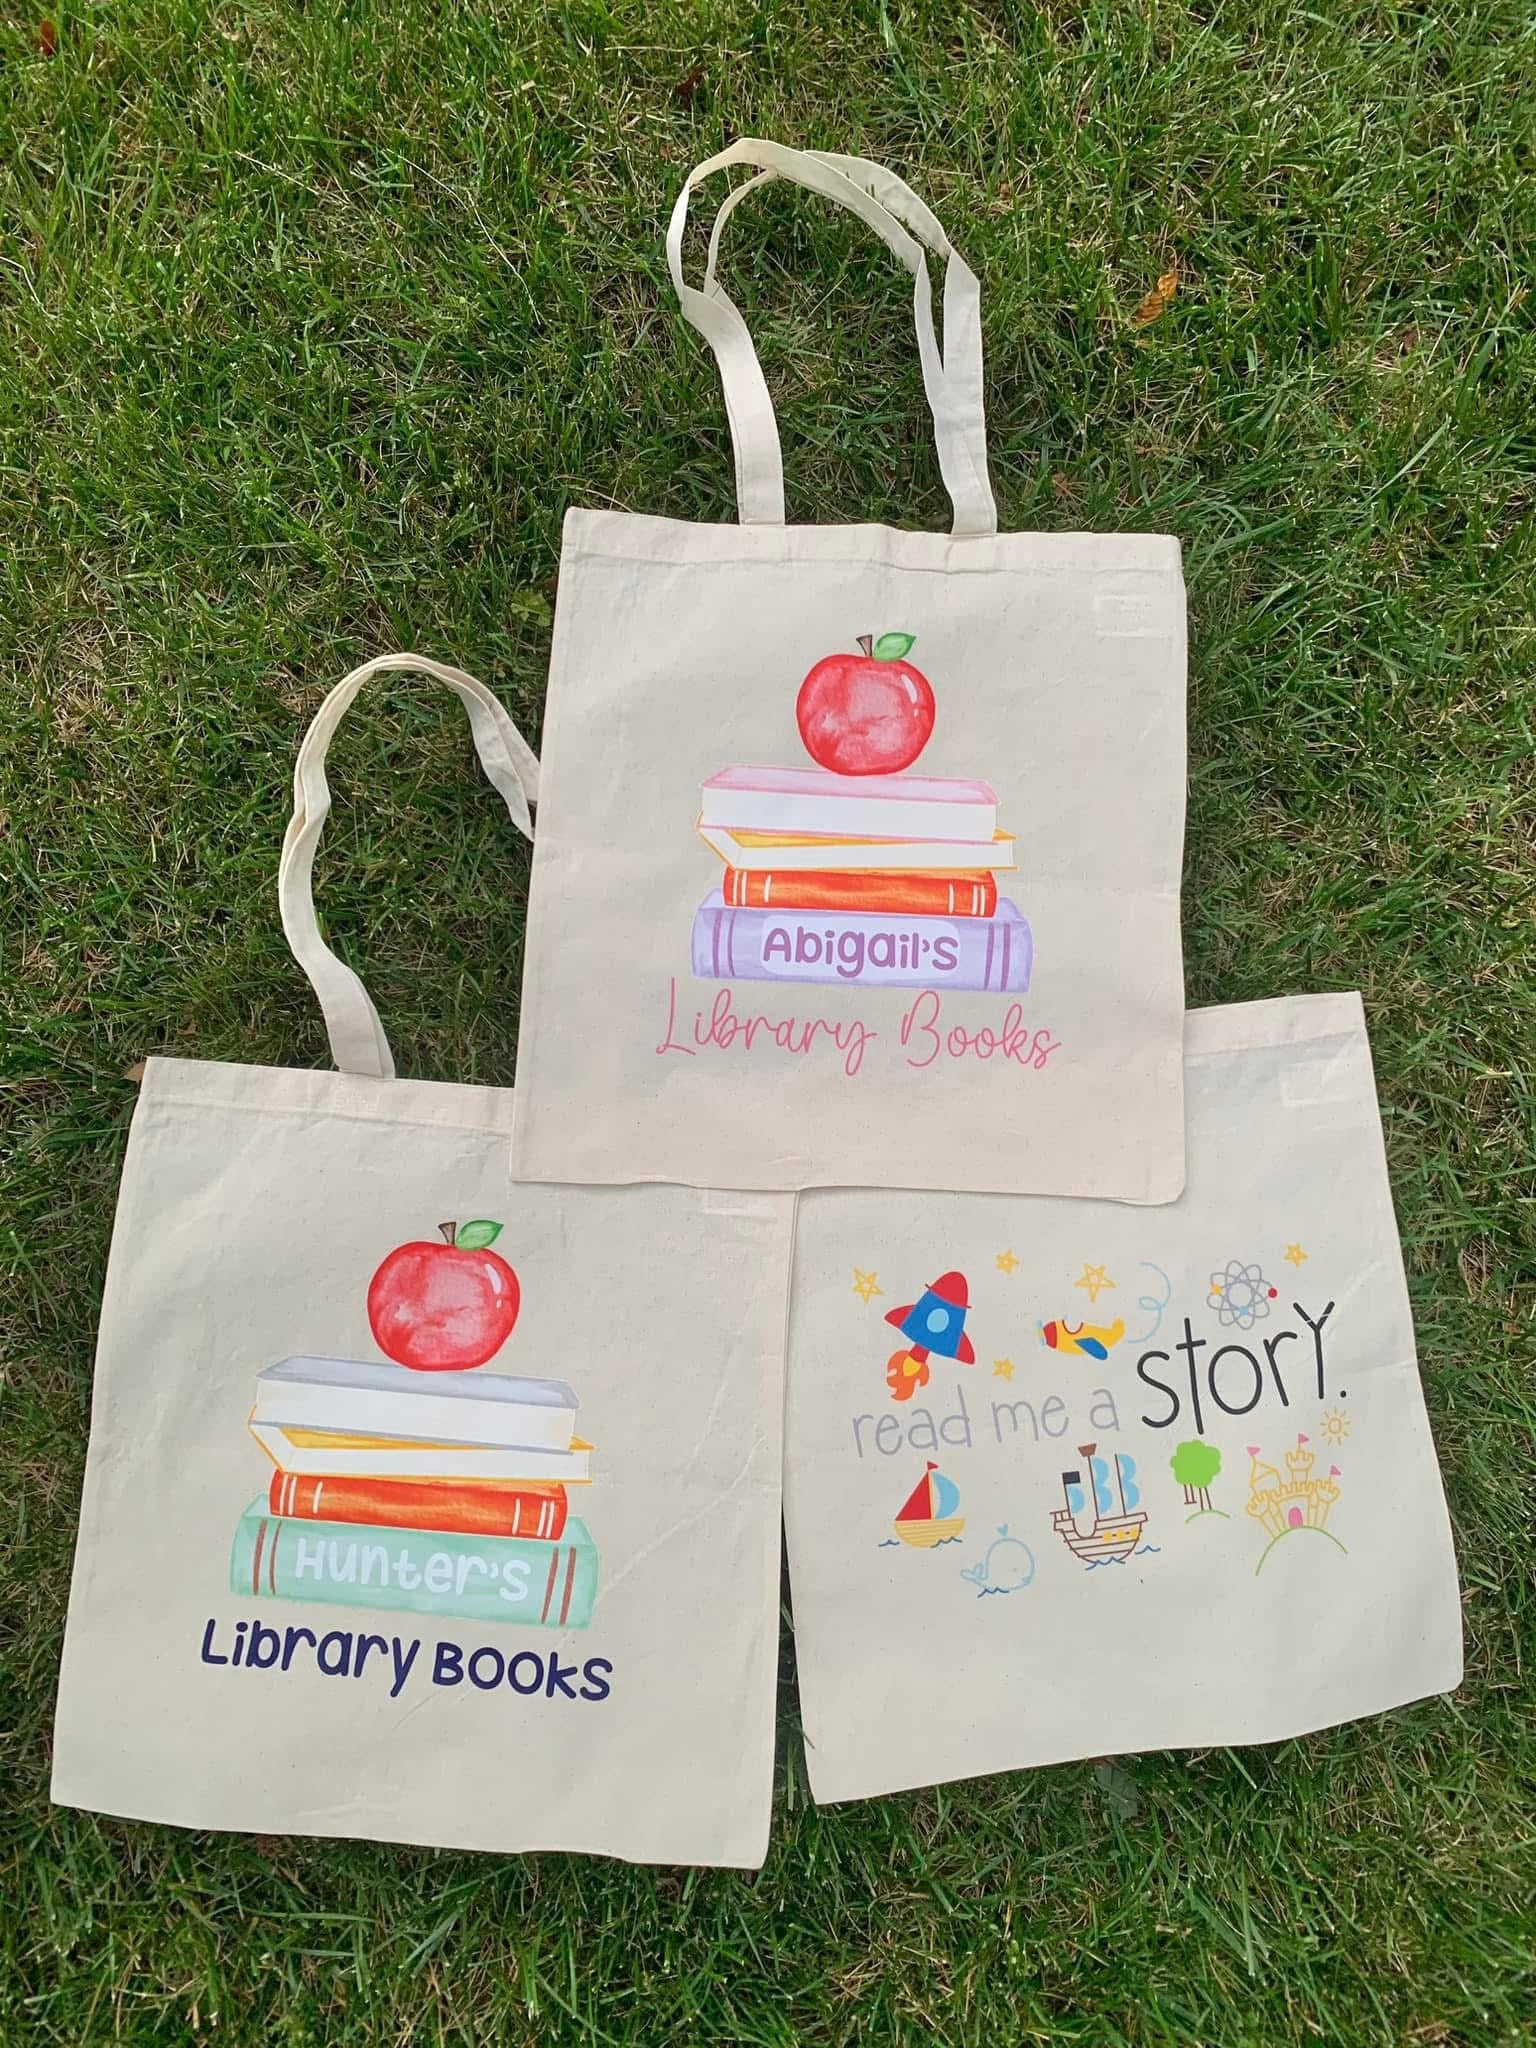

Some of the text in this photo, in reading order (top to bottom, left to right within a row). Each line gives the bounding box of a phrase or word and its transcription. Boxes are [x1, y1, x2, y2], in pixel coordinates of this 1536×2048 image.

[762, 926, 959, 978] Abigail's
[655, 976, 1062, 1076] Library Books
[852, 1384, 972, 1458] read
[991, 1394, 1070, 1443] me
[1088, 1388, 1120, 1432] a
[294, 1537, 532, 1601] Hunter's
[200, 1618, 421, 1698] Library
